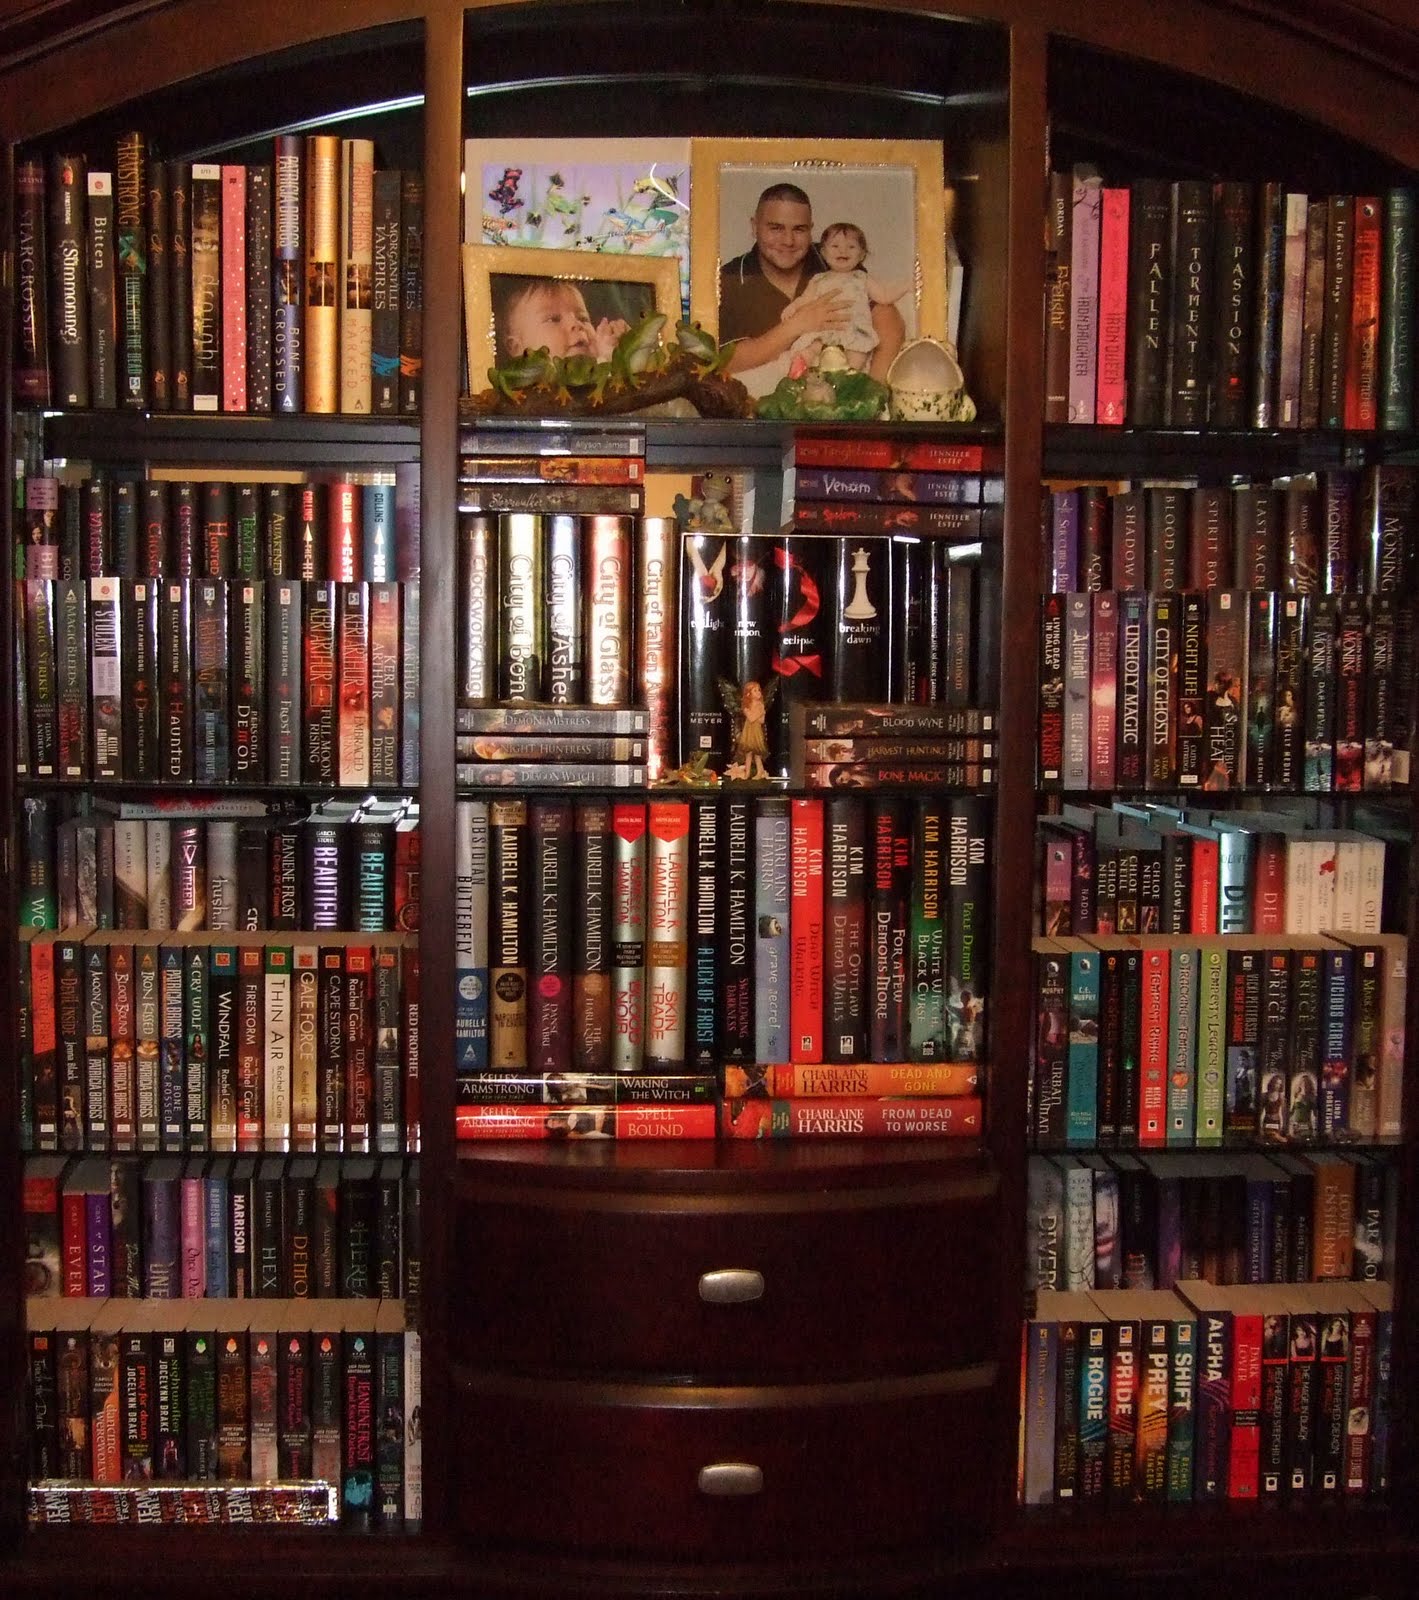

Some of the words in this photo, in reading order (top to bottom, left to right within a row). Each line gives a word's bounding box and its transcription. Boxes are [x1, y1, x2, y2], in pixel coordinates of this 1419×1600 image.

[117, 141, 141, 225] ARMSTRONG
[279, 156, 299, 202] PATRICIA
[94, 217, 107, 269] Bitten
[279, 207, 299, 248] BRIGGS
[375, 224, 386, 309] VAMPIRES
[387, 223, 398, 311] MORGANVILLE
[126, 277, 142, 304] LIVING
[1186, 248, 1199, 353] TORMENT
[1229, 247, 1243, 356] PASSION
[127, 308, 143, 331] WITH
[194, 274, 219, 371] drought
[127, 335, 143, 349] THE
[275, 308, 286, 391] CROSSED
[290, 328, 299, 372] BONE
[1076, 324, 1088, 376] DAUGHTER
[127, 353, 143, 374] DEAD
[374, 493, 384, 522] COLLINS
[938, 520, 962, 528] ESTEP
[1382, 518, 1399, 592] MONING
[547, 554, 573, 609] City
[599, 557, 620, 606] City
[66, 605, 77, 643] MAGIC
[94, 611, 115, 651] STOLEN
[599, 613, 620, 629] of
[839, 623, 880, 634] breaking
[847, 635, 871, 644] dawn
[1045, 622, 1052, 630] IN
[783, 636, 815, 653] eclipse
[1124, 625, 1138, 690] UNHOLY
[1154, 628, 1169, 661] CITY
[1185, 624, 1198, 666] NIGHT
[1313, 631, 1327, 677] MONING
[1342, 631, 1357, 676] MONING
[67, 646, 77, 685] BLEEDS
[372, 644, 384, 699] ARTHUR
[384, 655, 396, 686] KERI
[404, 643, 415, 700] ARTHUR
[600, 635, 620, 697] Glass
[1154, 665, 1169, 685] OF
[1185, 669, 1197, 695] LIFE
[319, 710, 331, 734] FULL
[883, 718, 913, 728] BLOOD
[917, 718, 944, 728] WYNE
[1124, 694, 1138, 744] MAGIC
[1155, 690, 1169, 744] GHOSTS
[107, 737, 118, 756] KELLEY
[309, 723, 319, 762] RISING
[321, 737, 331, 777] MOON
[372, 737, 383, 775] DESIRE
[383, 736, 393, 777] DEADLY
[1210, 726, 1225, 763] HEAT
[878, 771, 904, 781] BONE
[907, 771, 944, 781] MAGIC
[729, 805, 745, 867] LAURELL
[925, 816, 938, 844] KIM
[471, 817, 485, 885] OBSIDIAN
[502, 828, 517, 876] LAURELL
[542, 837, 557, 888] LAURELL
[586, 836, 601, 888] LAURELL
[793, 827, 807, 896] HARRISON
[809, 849, 822, 875] KIM
[832, 824, 847, 897] HARRISON
[850, 847, 864, 874] KIM
[877, 816, 892, 889] HARRISON
[894, 837, 910, 866] KIM
[950, 817, 967, 885] HARRISON
[969, 838, 984, 864] KIM
[502, 880, 517, 897] K.
[653, 857, 667, 928] HAMILTON
[729, 871, 745, 884] K.
[924, 850, 937, 919] HARRISON
[1098, 864, 1107, 894] NEILL
[1107, 861, 1116, 898] CHLOE
[1120, 859, 1129, 890] NEILL
[1128, 856, 1137, 893] CHLOE
[1142, 865, 1151, 896] NEILL
[1151, 861, 1160, 899] CHLOE
[457, 876, 472, 954] BUTTERFLY
[542, 891, 557, 906] K.
[587, 892, 601, 905] K.
[502, 902, 517, 964] HAMILTON
[542, 911, 558, 973] HAMILTON
[586, 908, 601, 970] HAMILTON
[729, 889, 746, 965] HAMILTON
[191, 970, 201, 992] CRY
[270, 979, 286, 1023] THIN
[299, 972, 313, 1009] GALE
[329, 975, 341, 1009] CAPE
[348, 979, 359, 1011] Rachel
[379, 969, 388, 997] Rachel
[1268, 968, 1278, 1023] PRICE
[1299, 969, 1311, 1023] PRICE
[1328, 976, 1344, 1020] VICIOUS
[192, 996, 201, 1030] WOLF
[218, 992, 232, 1059] WINDFALL
[246, 985, 257, 1044] FIRESTORM
[349, 1014, 359, 1041] Caine
[379, 1000, 388, 1025] Caine
[409, 1004, 418, 1026] RED
[652, 983, 664, 1040] TRADE
[665, 992, 678, 1030] SKIN
[271, 1031, 285, 1059] AIR
[300, 1014, 313, 1059] FORCE
[329, 1012, 341, 1057] STORM
[409, 1028, 418, 1078] PROPHET
[1328, 1023, 1343, 1058] CIRCLE
[243, 1056, 255, 1087] Rachel
[277, 1065, 285, 1092] Rachel
[462, 1083, 535, 1094] ARMSTRONG
[801, 1070, 869, 1079] CHARLAINE
[243, 1091, 255, 1118] Caine
[277, 1094, 285, 1118] Caine
[798, 1120, 864, 1133] HARRIS
[234, 1195, 245, 1253] HARRISON
[1322, 1185, 1337, 1273] ENSHRINED
[1339, 1193, 1349, 1238] LOVER
[262, 1248, 277, 1288] HEX
[1207, 1318, 1223, 1381] ALPHA
[1238, 1344, 1248, 1382] LOVER
[1249, 1347, 1259, 1377] DARK
[128, 1366, 136, 1410] JOCELYNN
[160, 1360, 168, 1403] JOCELYNN
[1087, 1357, 1103, 1420] ROGUE
[1116, 1351, 1133, 1415] PRIDE
[1148, 1353, 1166, 1411] PREY
[1175, 1353, 1191, 1410] SHIFT
[160, 1406, 169, 1432] DRAKE
[356, 1381, 371, 1428] JEANIENE
[128, 1413, 136, 1440] DRAKE
[358, 1431, 371, 1462] FROST
[1147, 1453, 1155, 1490] VINCENT
